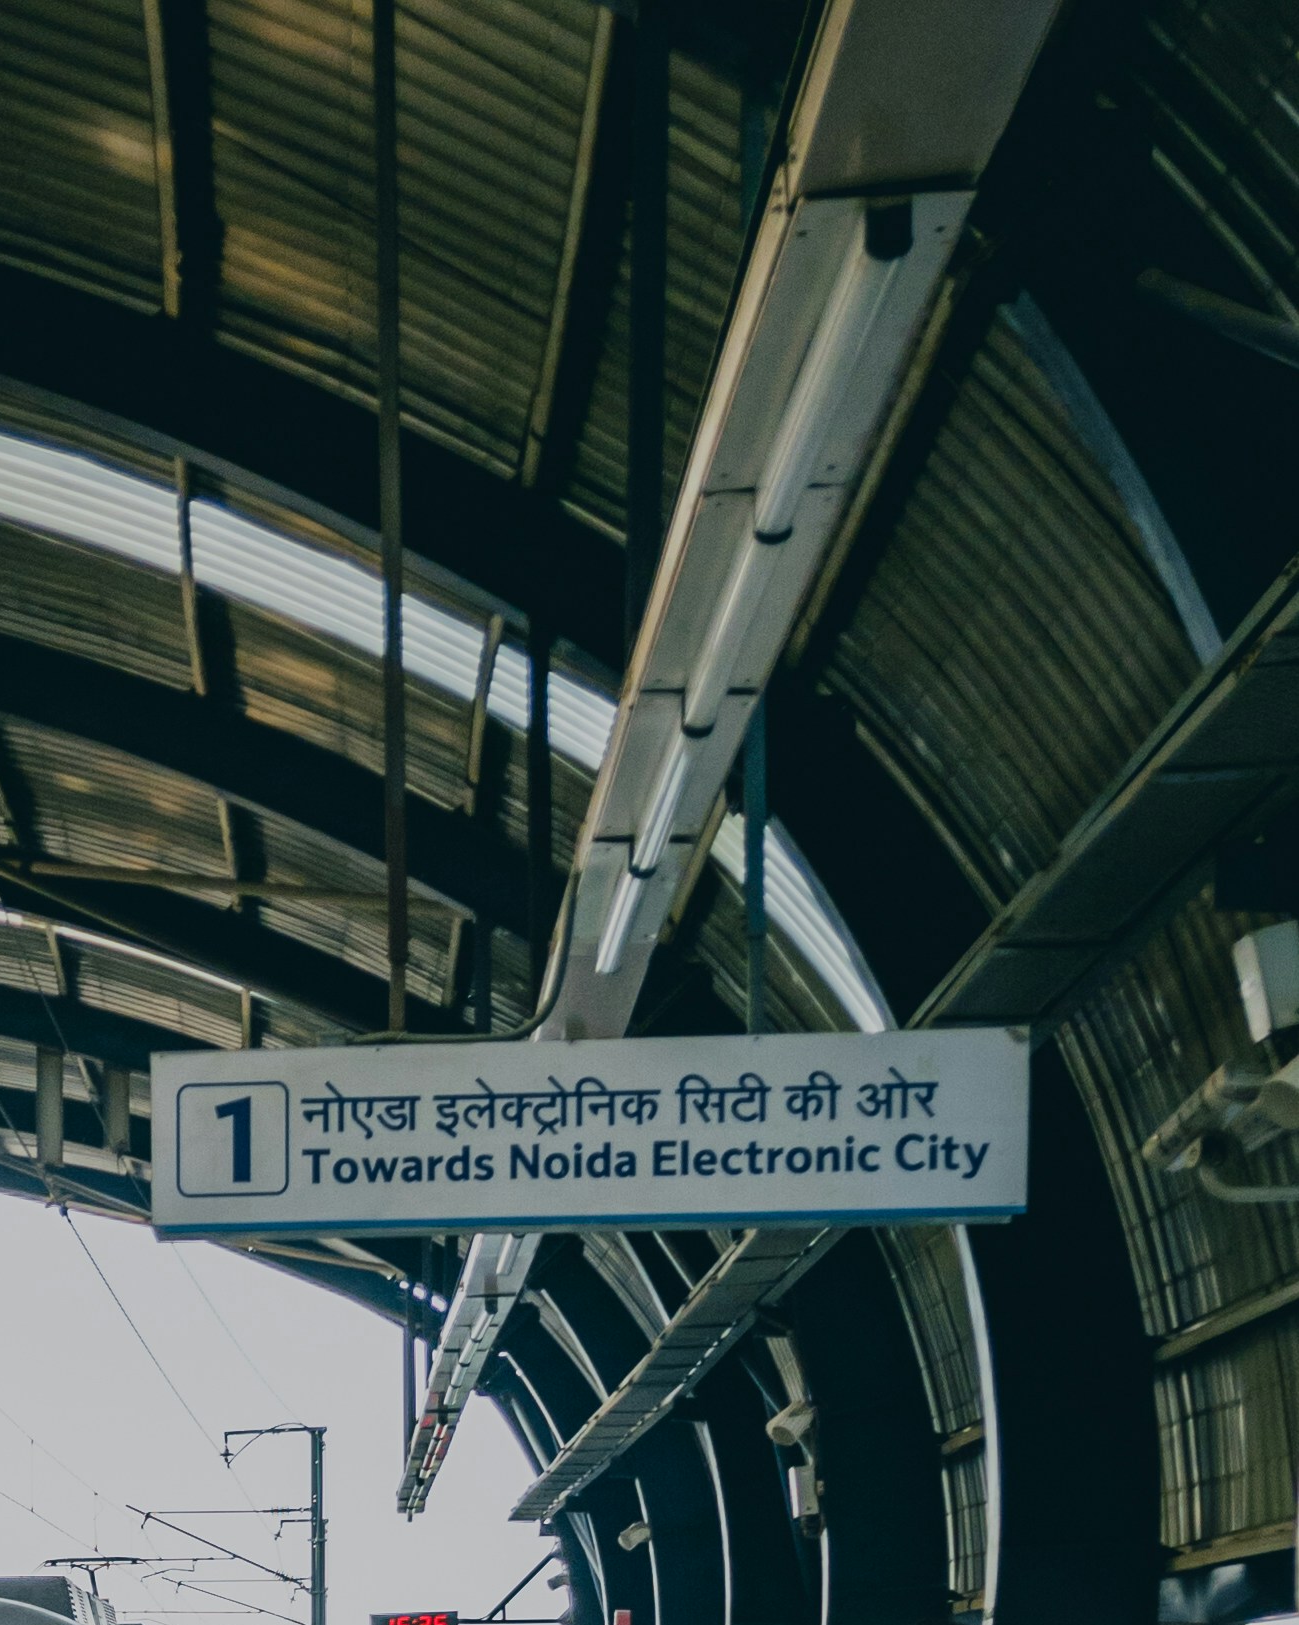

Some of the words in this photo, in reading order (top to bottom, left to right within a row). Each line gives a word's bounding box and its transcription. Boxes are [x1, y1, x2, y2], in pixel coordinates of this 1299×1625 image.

[214, 1095, 252, 1183] 1
[301, 1080, 421, 1139] नोएडा
[675, 1071, 772, 1126] सिटी
[783, 1069, 842, 1122] की
[856, 1065, 940, 1119] ओर
[301, 1144, 496, 1184] Towards
[509, 1140, 637, 1180] Noida
[651, 1135, 882, 1178] Electronic
[894, 1132, 991, 1180] City
